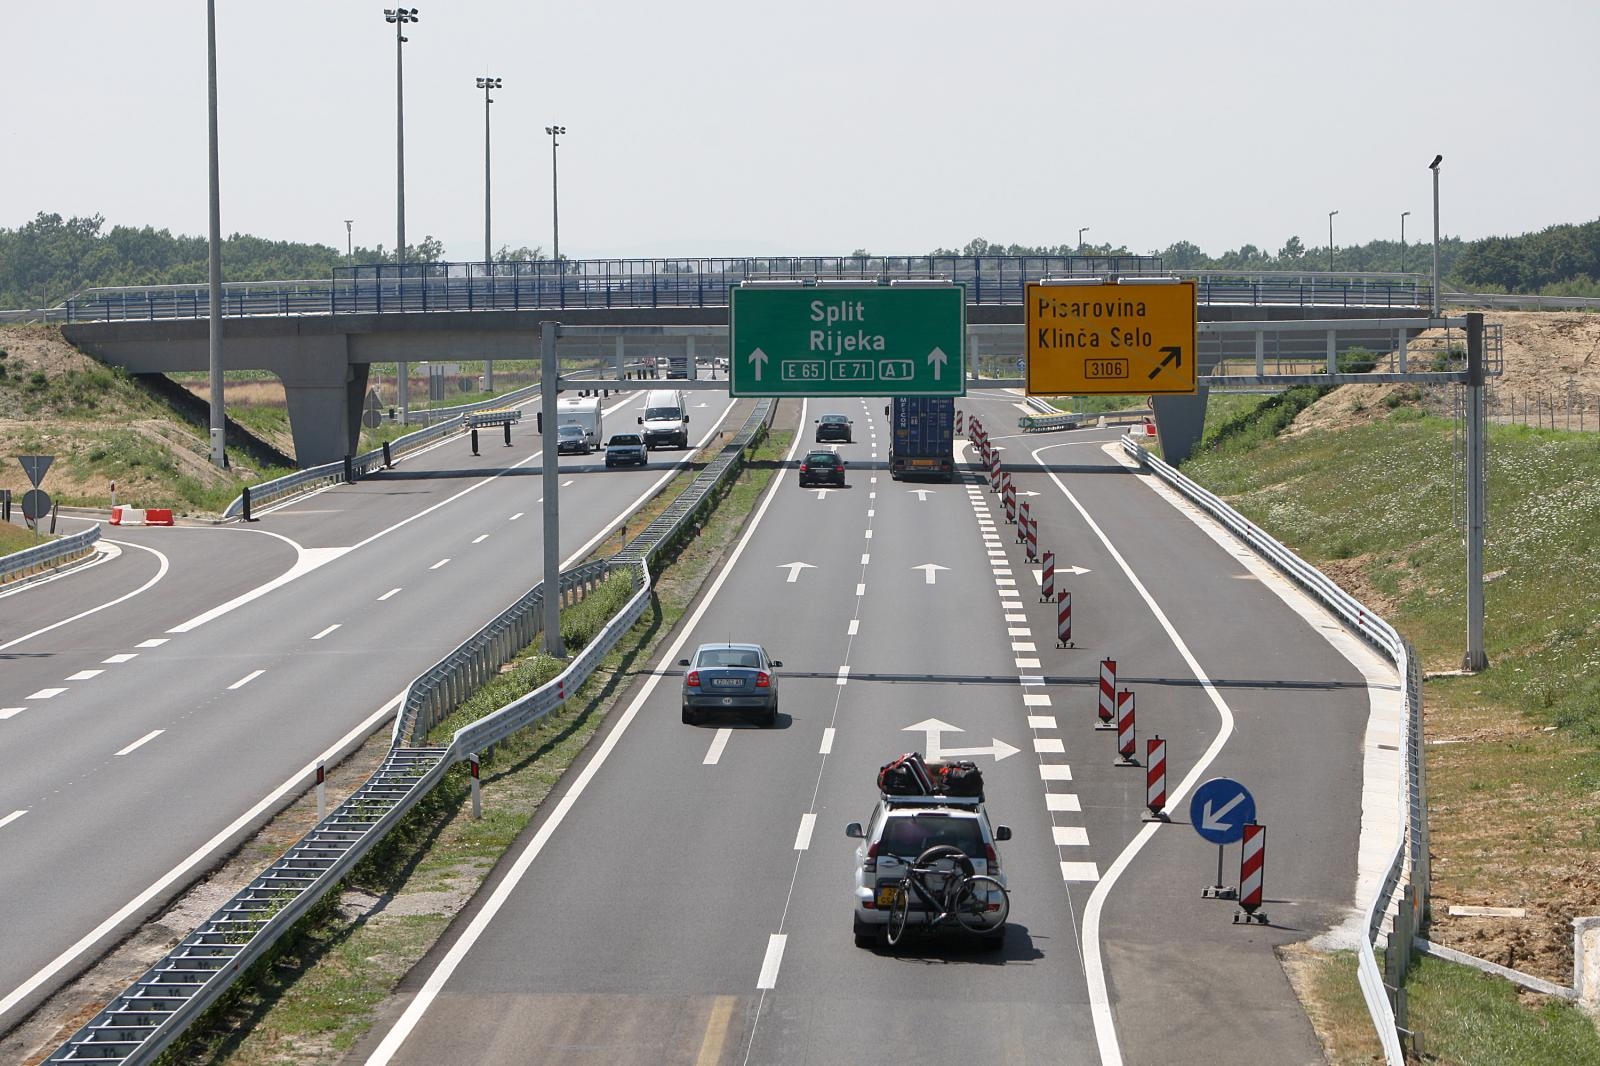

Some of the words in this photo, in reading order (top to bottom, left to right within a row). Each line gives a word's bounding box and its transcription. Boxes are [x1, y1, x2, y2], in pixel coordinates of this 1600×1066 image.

[810, 300, 865, 326] Split
[1038, 298, 1146, 318] Pisarovina
[810, 330, 885, 355] Rijeka
[1038, 328, 1100, 348] Klinča
[1110, 327, 1152, 348] Selo
[788, 364, 796, 377] E
[802, 364, 819, 377] 65
[839, 364, 846, 377] E
[852, 364, 866, 377] 71
[885, 363, 896, 377] A
[901, 363, 907, 377] 1
[1091, 362, 1122, 376] 3106
